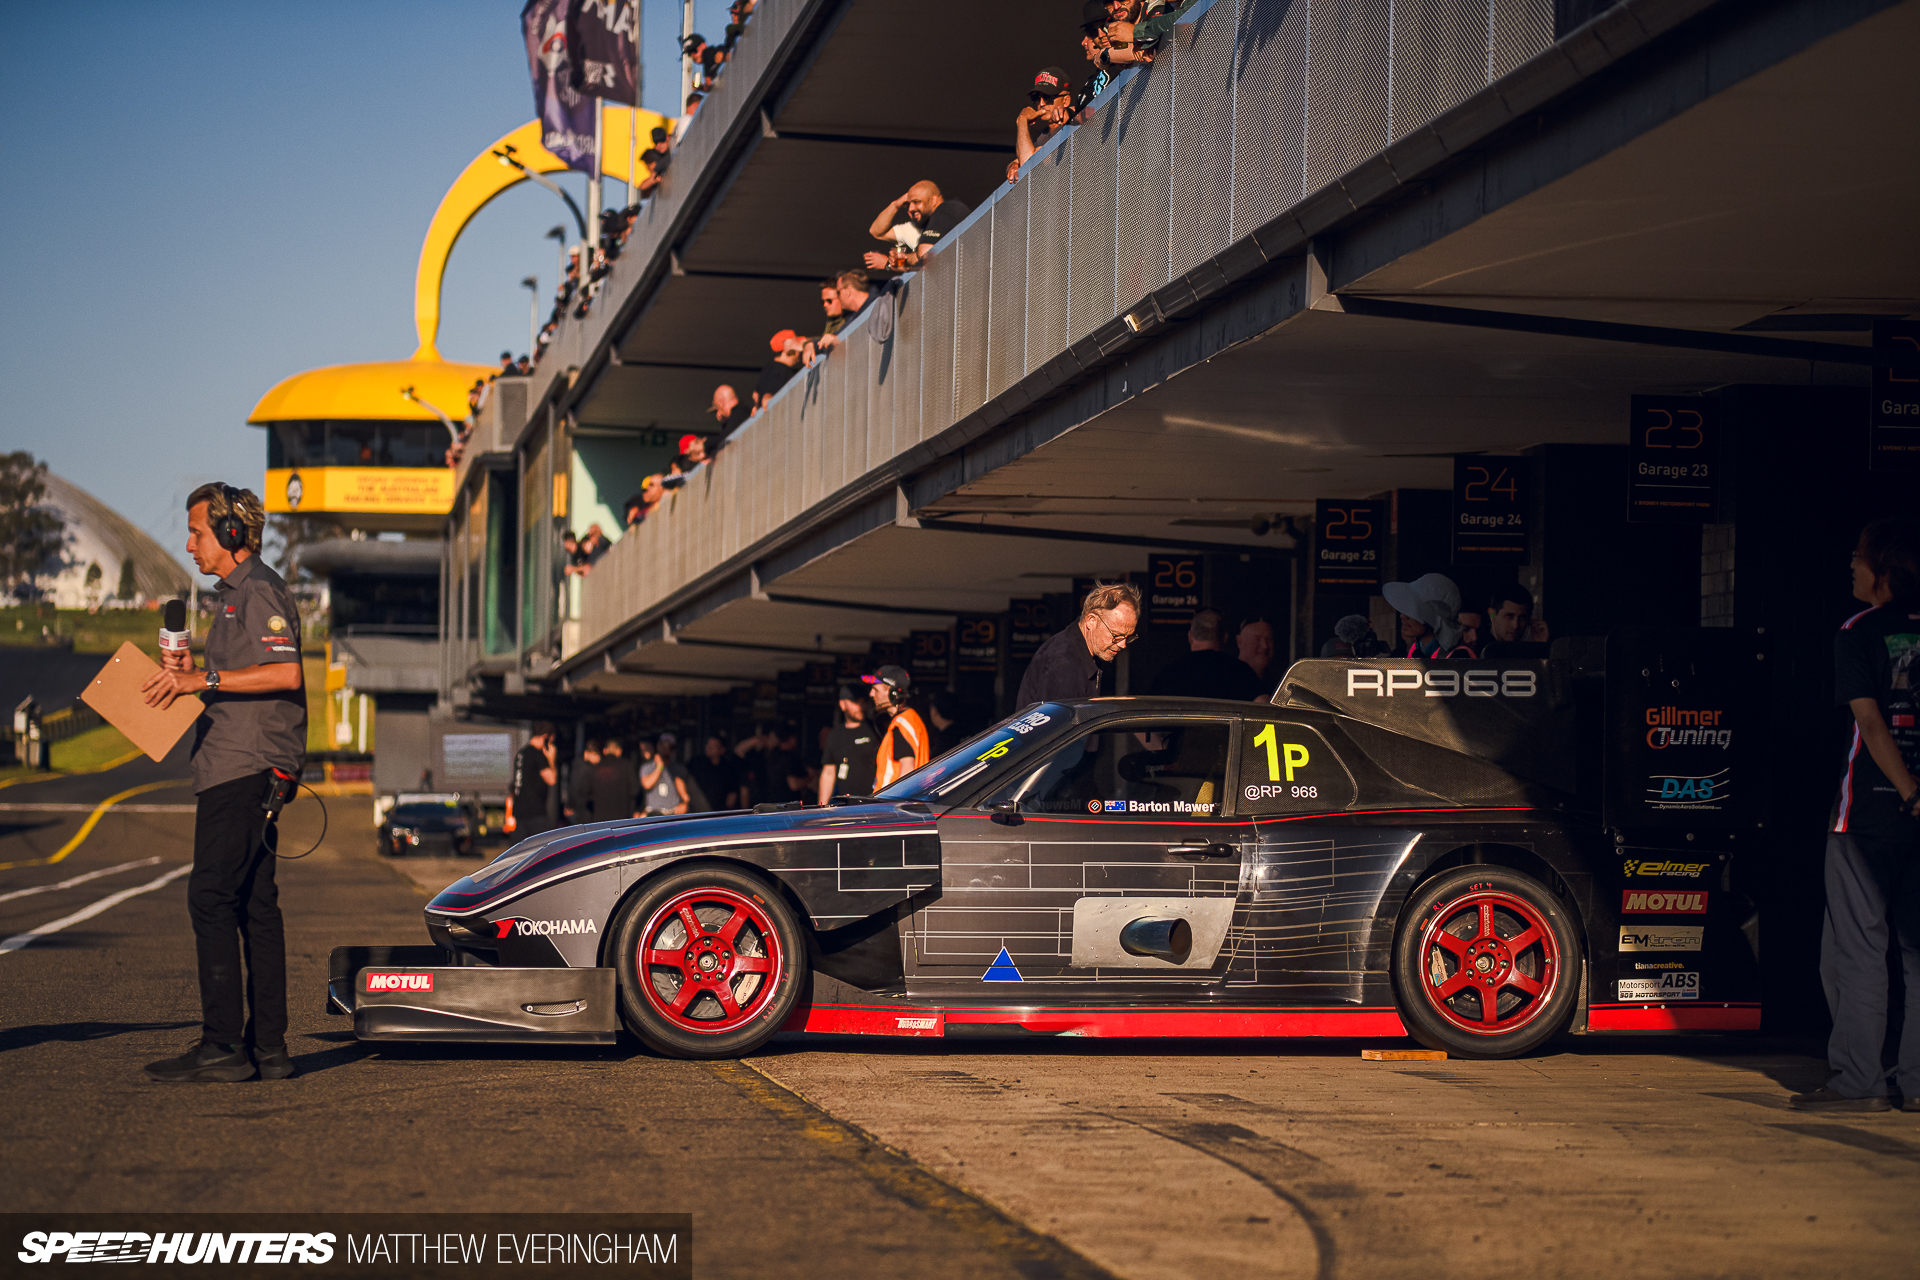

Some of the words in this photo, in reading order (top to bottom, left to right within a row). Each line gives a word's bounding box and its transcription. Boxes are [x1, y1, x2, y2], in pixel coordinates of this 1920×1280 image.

[1882, 399, 1920, 415] Gara
[1645, 408, 1703, 449] 23
[1638, 462, 1688, 479] Garage
[1692, 464, 1709, 477] 23
[1465, 466, 1518, 502] 24
[1325, 508, 1372, 540] 25
[1460, 513, 1504, 528] Garage
[1507, 514, 1522, 525] 24
[1321, 549, 1360, 563] Garage
[1362, 550, 1376, 561] 25
[1155, 560, 1196, 588] 26
[1152, 594, 1185, 607] Garage
[1186, 595, 1199, 605] 26
[962, 620, 995, 643] 29
[914, 634, 946, 656] 30
[1347, 669, 1537, 697] RP968
[1645, 706, 1723, 726] Gillmer
[1657, 726, 1732, 750] Tuning
[976, 737, 1014, 762] 1P
[1253, 723, 1310, 782] 1P
[1244, 785, 1283, 801] @RP
[1290, 785, 1318, 798] 968
[1660, 778, 1715, 799] DAS
[1129, 800, 1171, 812] Barton
[1173, 800, 1215, 812] Mawer
[1636, 860, 1710, 876] elmer
[1469, 882, 1483, 892] SET
[1626, 893, 1704, 911] MOTUL
[515, 918, 598, 936] YOKOHAMA
[1621, 934, 1700, 947] EMtron
[1634, 962, 1685, 970] tianacreative.
[369, 975, 430, 989] MOTUL
[1619, 981, 1661, 990] Motorsport
[1661, 973, 1698, 988] ABS
